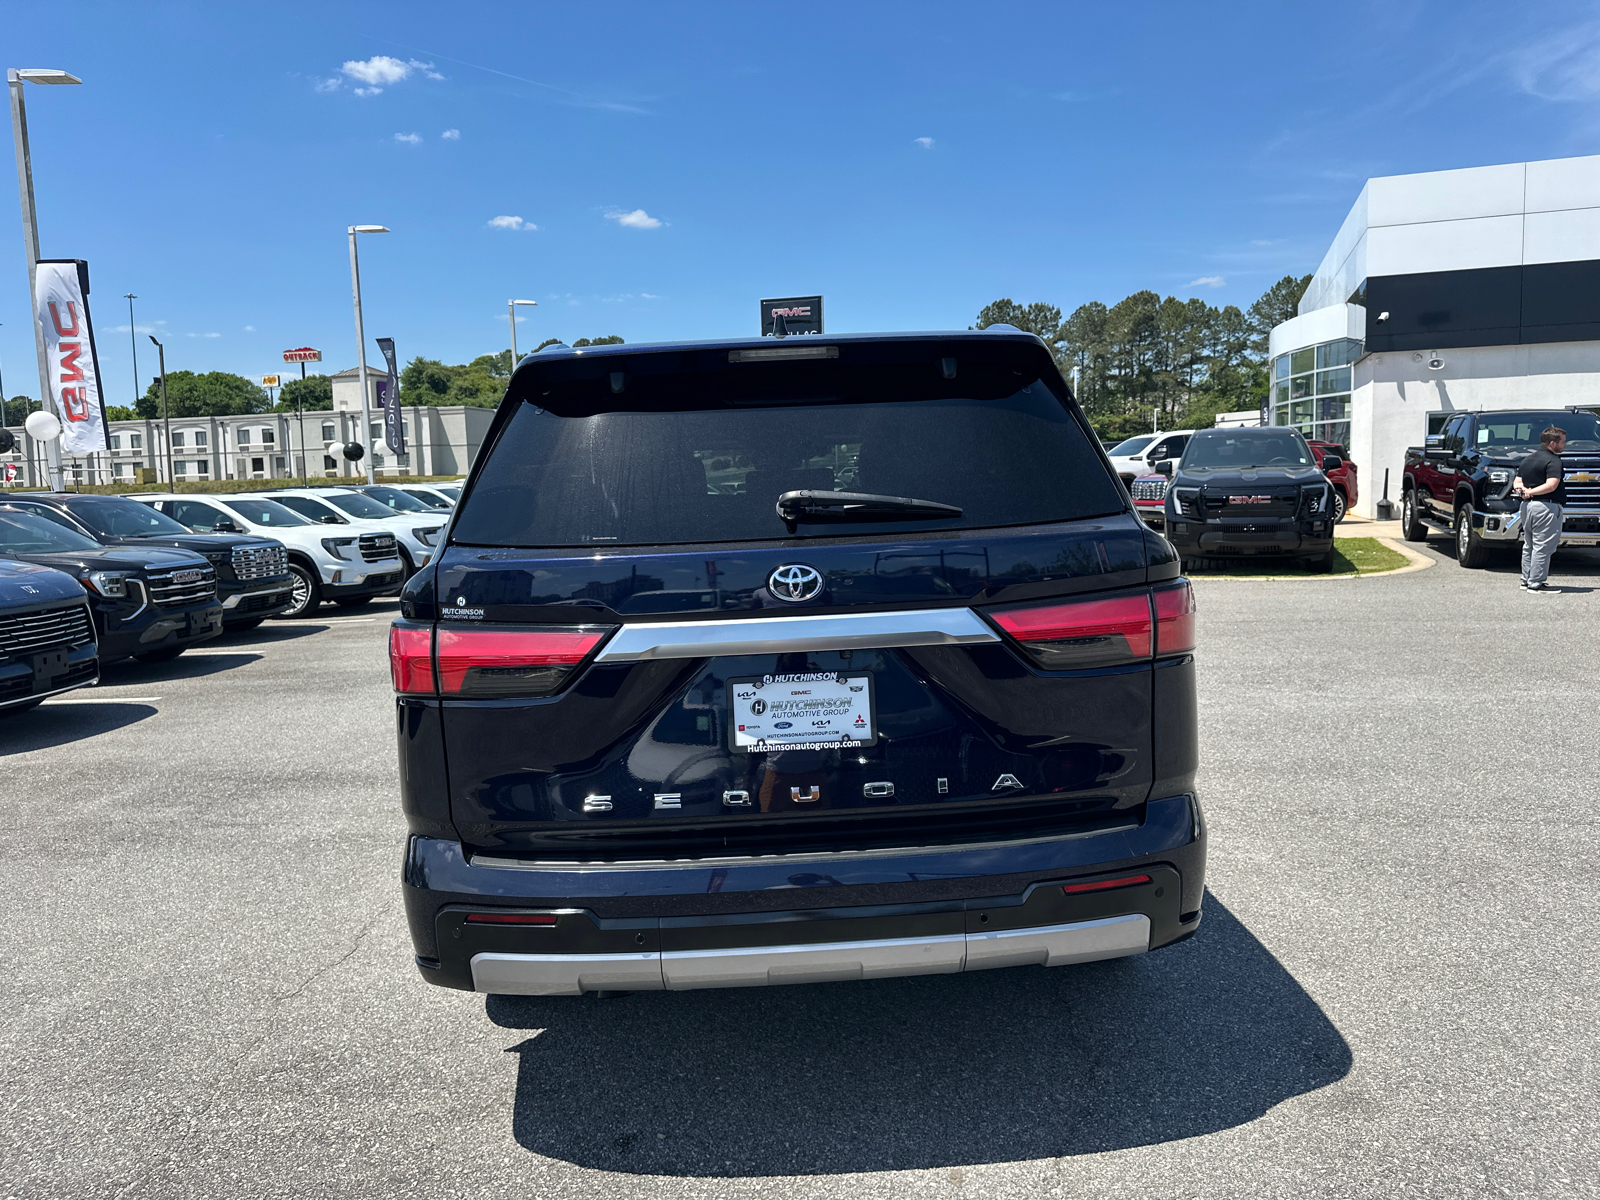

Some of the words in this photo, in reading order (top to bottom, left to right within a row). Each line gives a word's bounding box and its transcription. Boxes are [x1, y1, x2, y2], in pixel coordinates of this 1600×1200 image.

[771, 306, 811, 318] GMC
[283, 352, 317, 361] OUTBACK
[1229, 495, 1271, 504] GMC
[774, 672, 838, 683] HUTCHINSON
[770, 697, 852, 712] HUTCHINSON
[771, 710, 821, 719] AUTOMOTIVE
[823, 708, 850, 717] GROUP
[747, 740, 861, 753] Hutchinsonautogroup.com
[583, 773, 1025, 812] SEQUOIA
